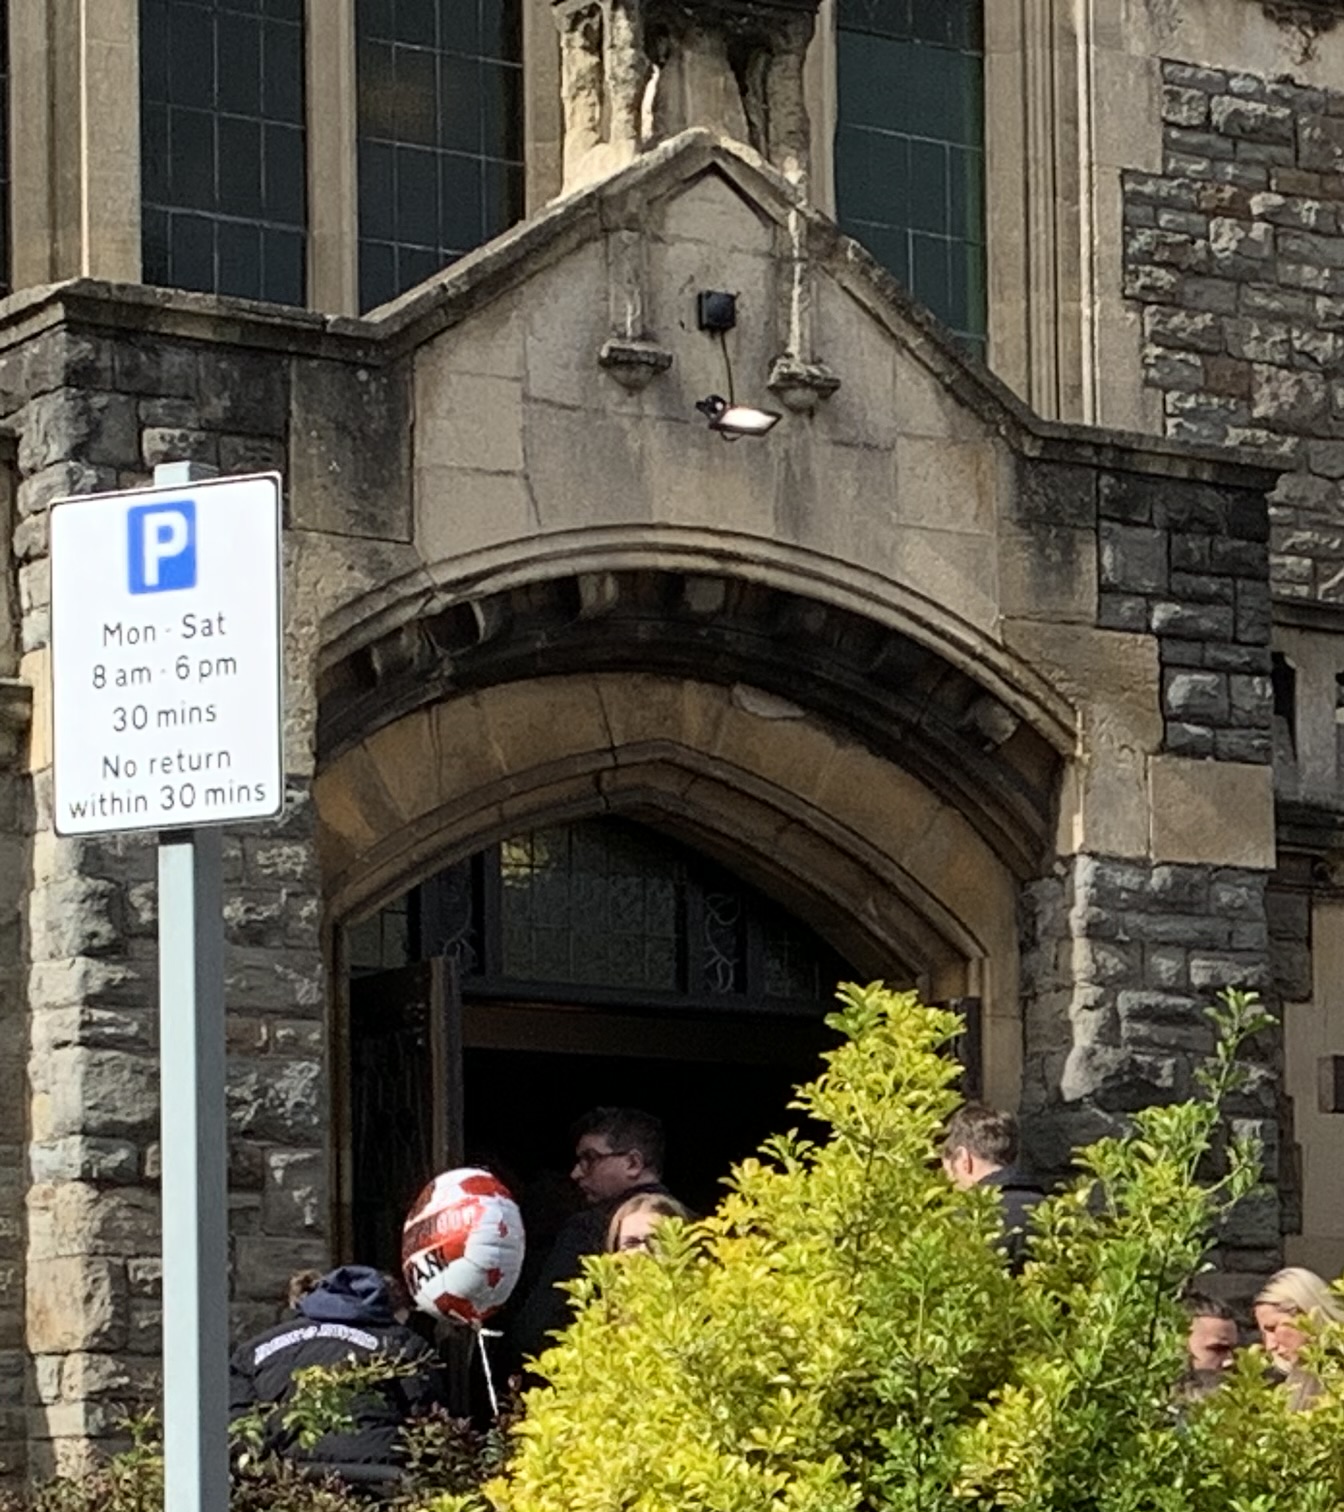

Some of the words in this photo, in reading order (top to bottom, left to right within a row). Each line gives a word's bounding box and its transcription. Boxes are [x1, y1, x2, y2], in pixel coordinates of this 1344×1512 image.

[142, 511, 189, 587] P
[102, 622, 156, 647] Mon
[181, 612, 226, 639] Sat
[92, 664, 107, 689] 8
[115, 666, 152, 687] am
[175, 655, 190, 680] 6
[198, 656, 237, 683] pm
[112, 704, 148, 732] 30
[157, 700, 217, 727] mins
[102, 755, 137, 779] No
[149, 750, 231, 775] return
[69, 789, 148, 819] within
[159, 783, 196, 811] 30
[204, 779, 266, 806] mins
